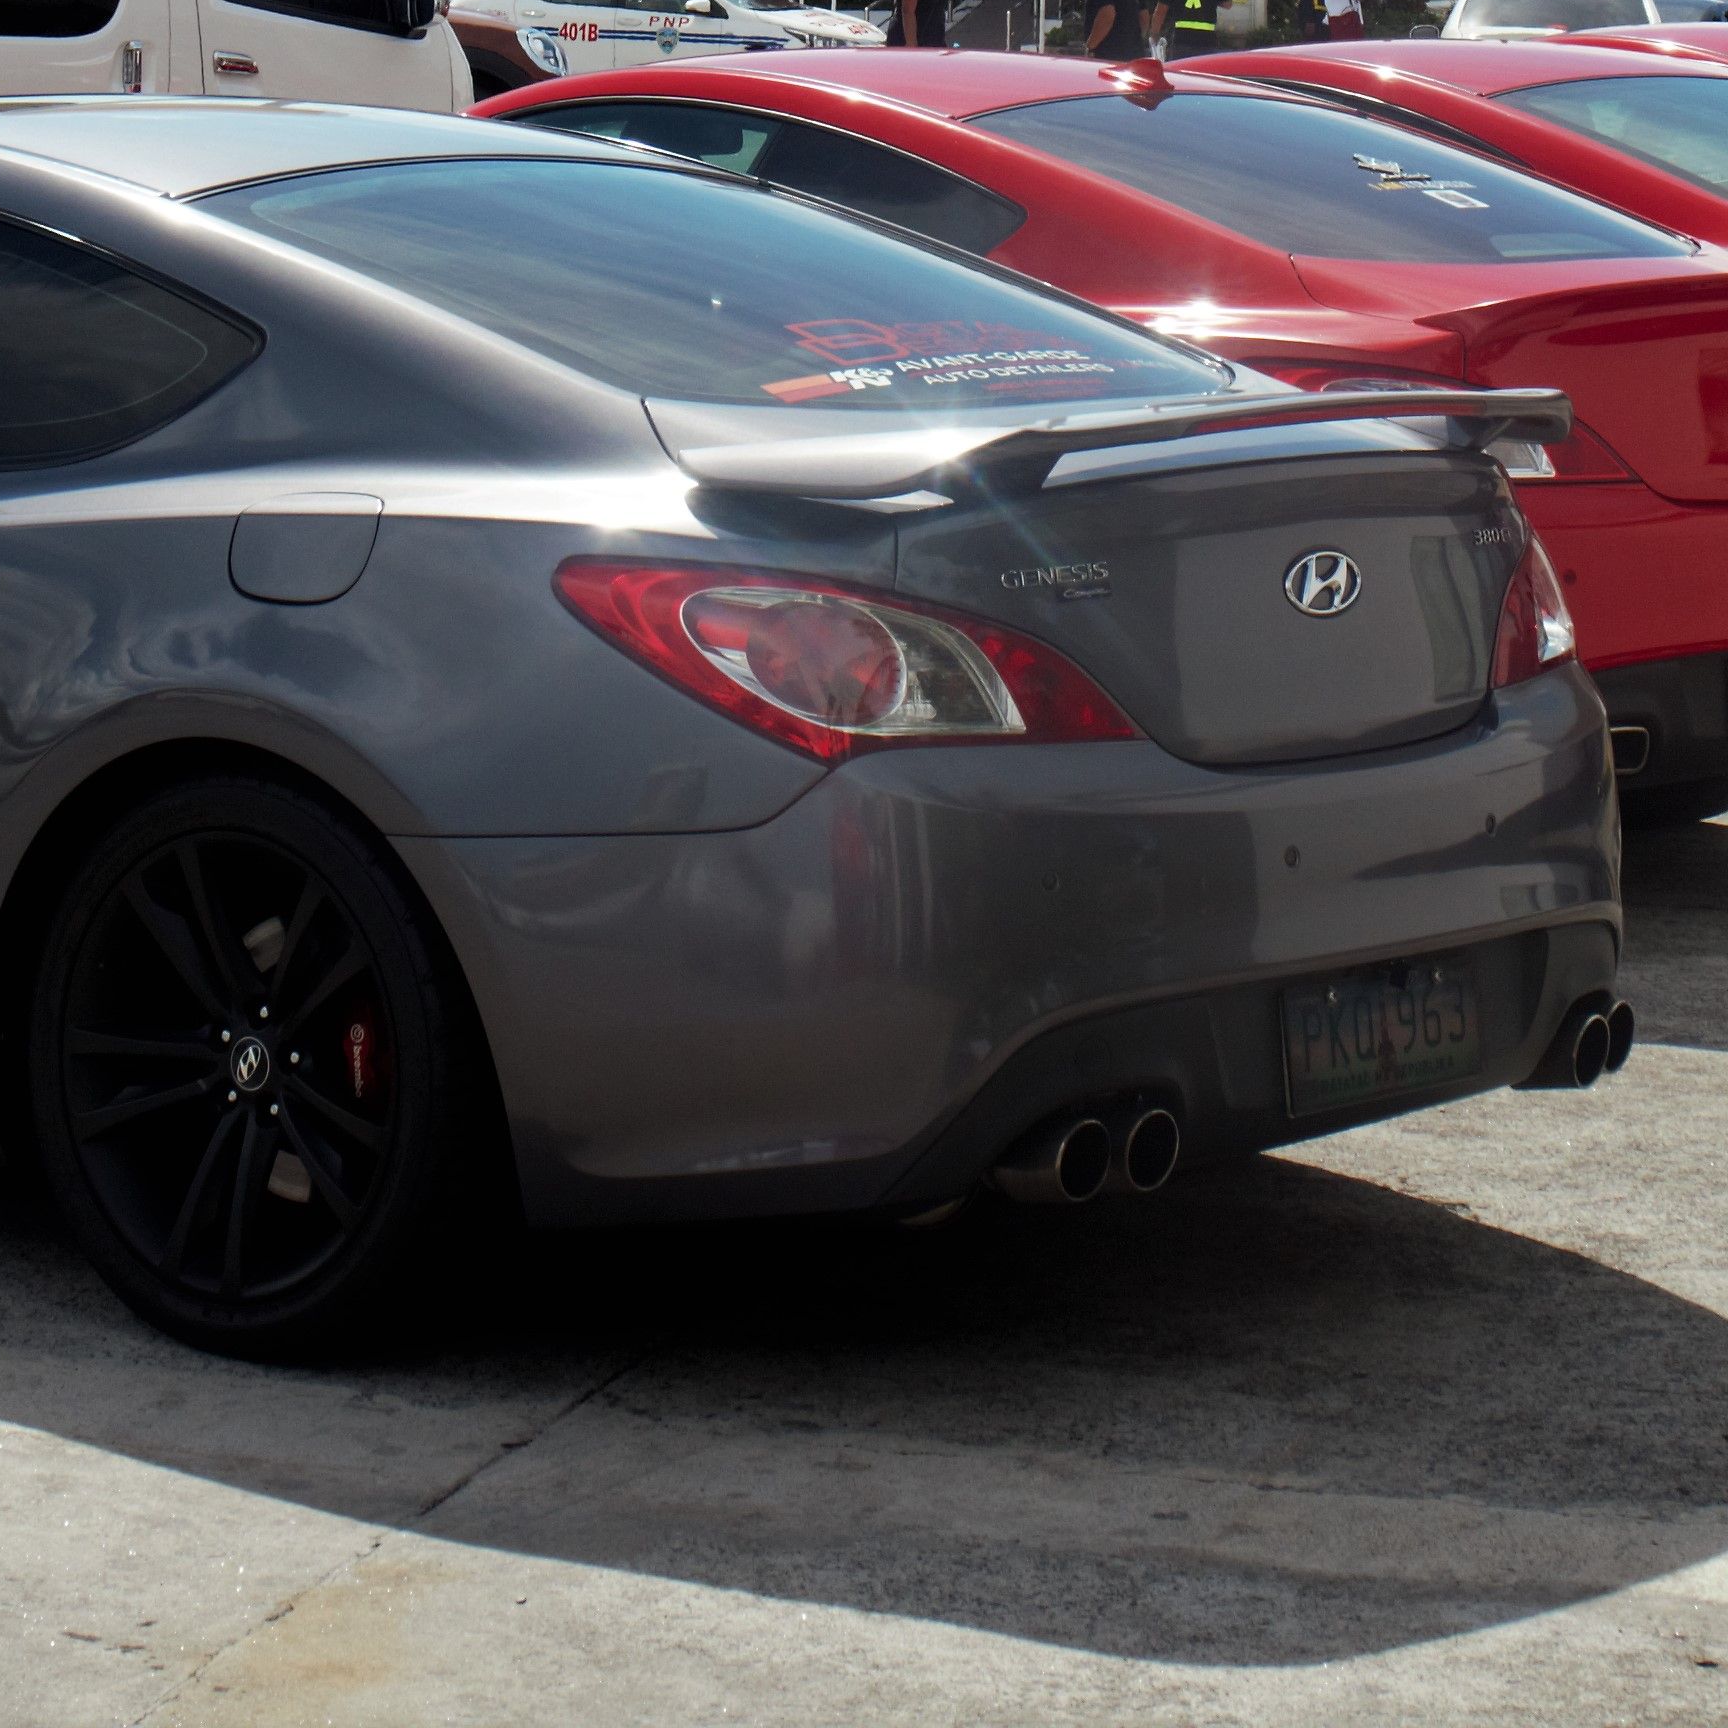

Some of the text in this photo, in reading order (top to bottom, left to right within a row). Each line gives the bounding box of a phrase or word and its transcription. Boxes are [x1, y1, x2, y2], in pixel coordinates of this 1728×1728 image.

[558, 22, 599, 42] 401B
[648, 15, 691, 28] PNP
[895, 349, 1091, 373] AVANT-GARDE
[922, 368, 990, 386] AUTO
[990, 362, 1115, 379] DETAILERS
[1000, 560, 1111, 589] GENESIS
